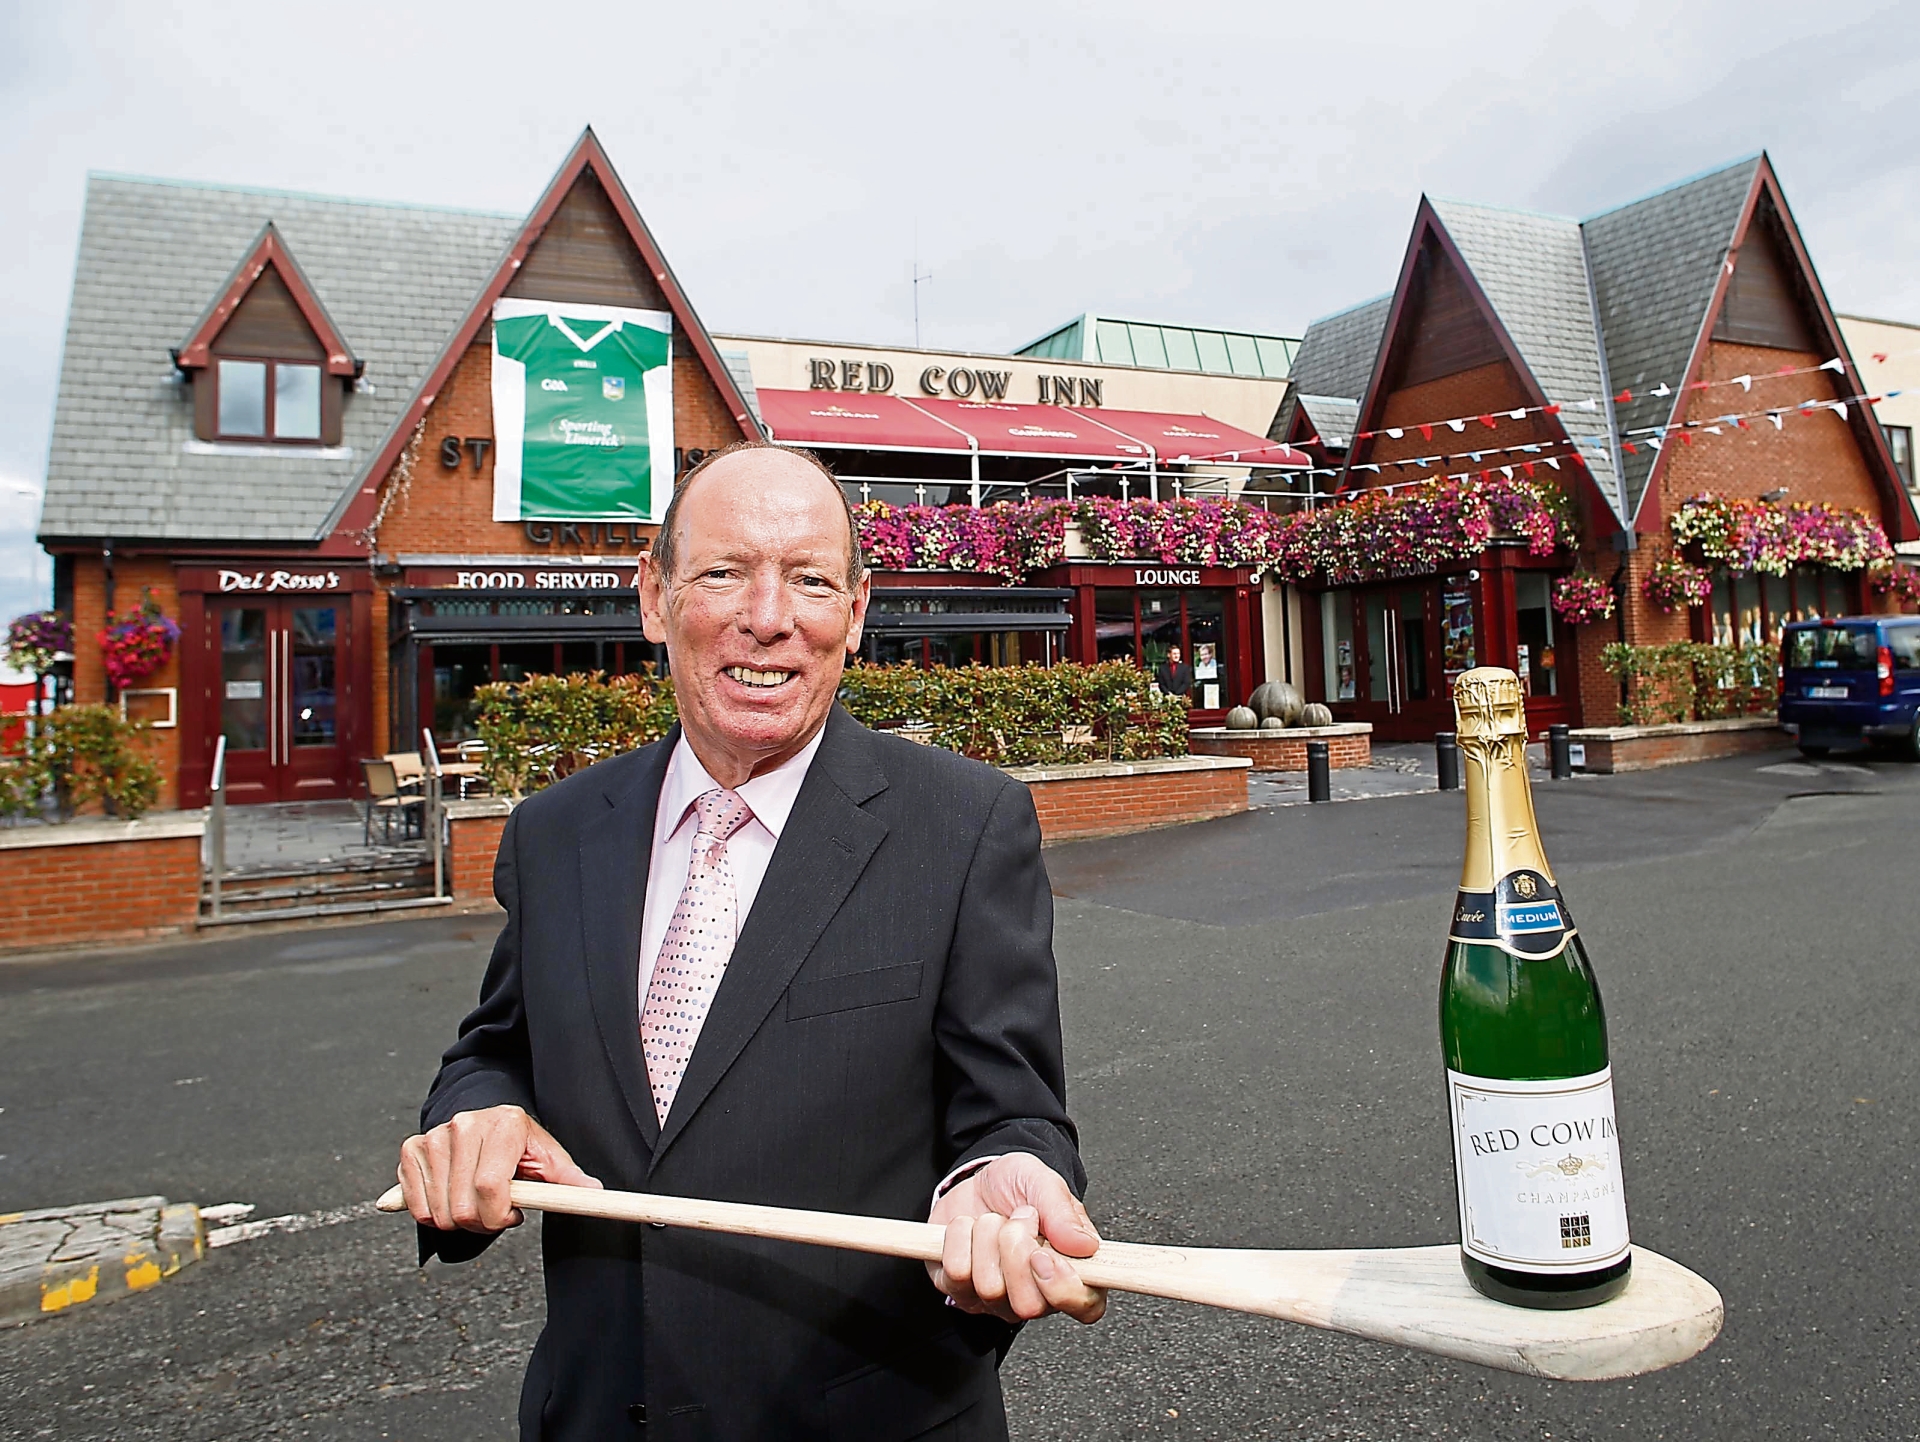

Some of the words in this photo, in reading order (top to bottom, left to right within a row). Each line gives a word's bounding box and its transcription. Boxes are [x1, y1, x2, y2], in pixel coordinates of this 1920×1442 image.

[809, 357, 894, 393] RED
[919, 365, 1013, 400] COW
[1037, 374, 1104, 406] INN
[559, 419, 612, 437] Sporting
[565, 432, 619, 446] Limerick
[218, 570, 265, 592] Del
[457, 572, 525, 589] FOOD
[535, 572, 620, 589] SERVED
[1134, 569, 1201, 585] LOUNGE
[1455, 905, 1486, 923] Cuvée
[1504, 911, 1558, 924] MEDIUM
[1469, 1128, 1520, 1157] RED
[1530, 1117, 1595, 1147] COW
